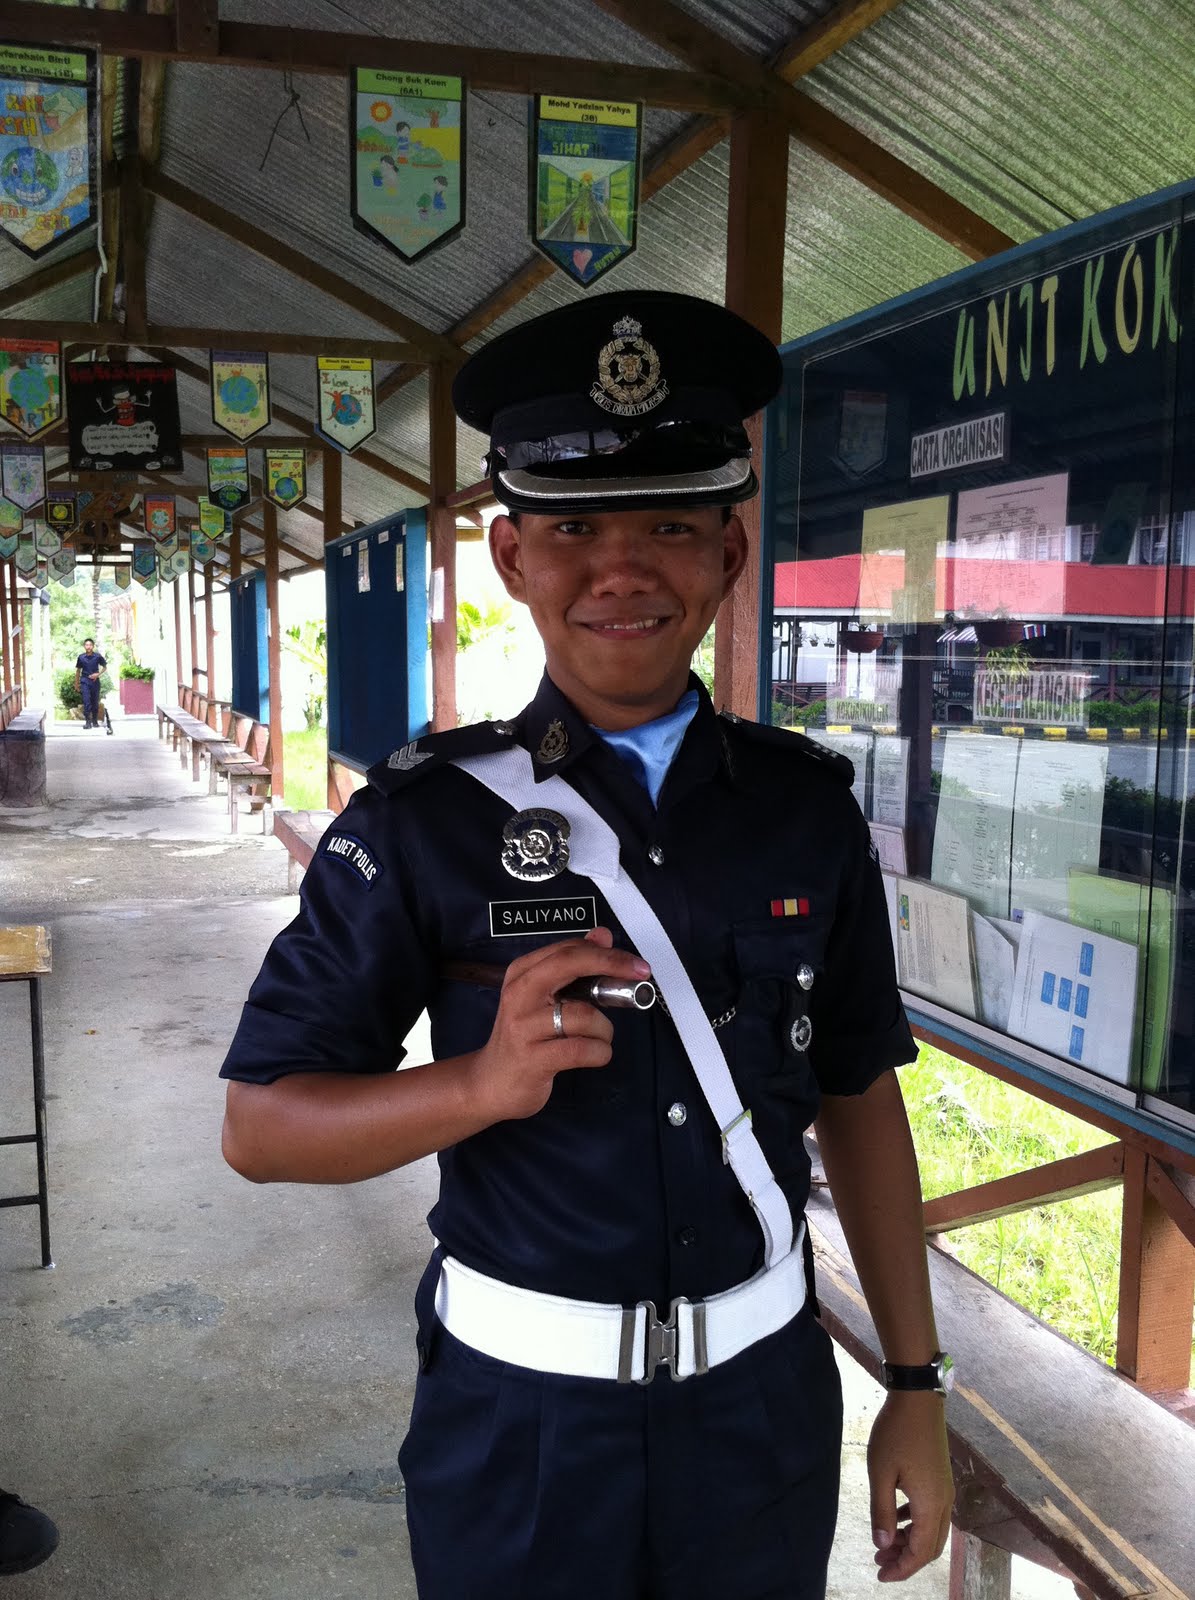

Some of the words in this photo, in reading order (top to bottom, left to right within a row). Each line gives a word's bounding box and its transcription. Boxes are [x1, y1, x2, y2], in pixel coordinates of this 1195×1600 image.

[48, 55, 71, 64] Binti
[376, 73, 402, 84] Chong
[406, 76, 421, 85] Suk
[548, 99, 570, 108] Mohd
[606, 105, 631, 115] Yahya
[581, 114, 598, 123] (3B)
[552, 142, 590, 157] SIHAT
[912, 433, 940, 475] CARTA
[942, 416, 1004, 467] ORGANISASI
[326, 837, 357, 857] KADET
[352, 848, 378, 881] POLIS
[502, 906, 587, 925] SALIYANO
